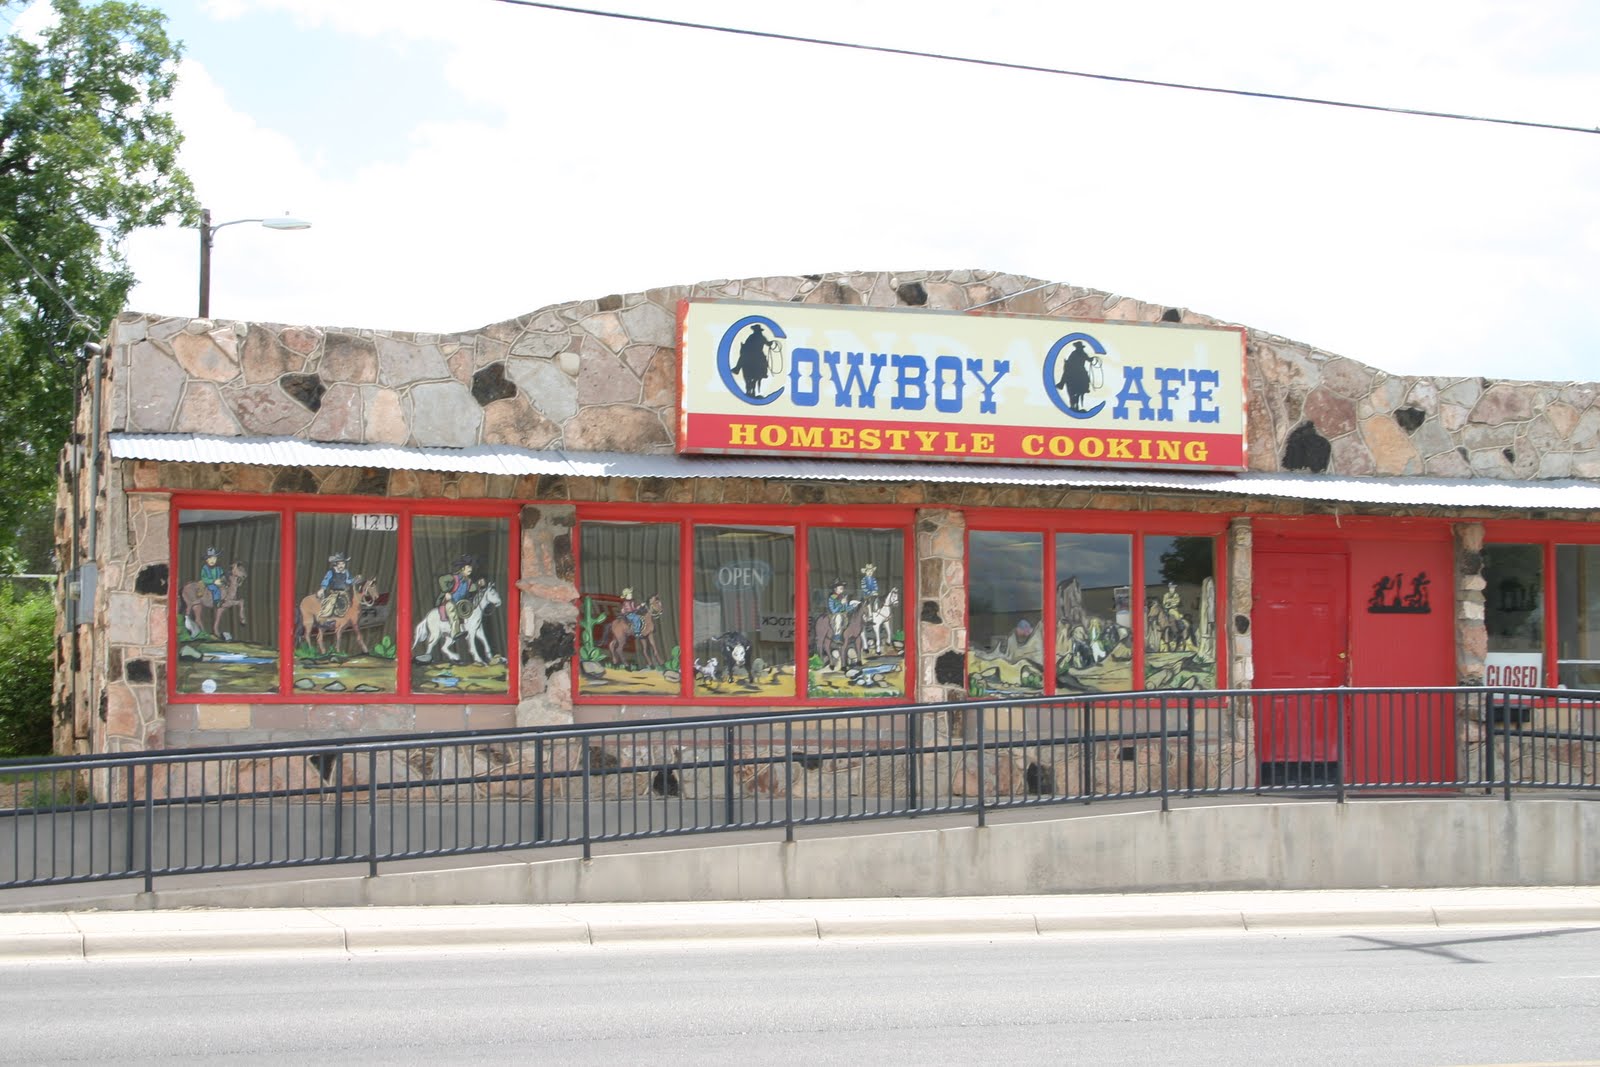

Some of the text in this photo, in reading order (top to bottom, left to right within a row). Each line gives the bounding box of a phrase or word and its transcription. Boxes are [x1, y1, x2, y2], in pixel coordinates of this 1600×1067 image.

[717, 315, 1010, 414] COWBOY
[1042, 332, 1220, 423] CAFE
[728, 423, 1209, 462] HOMESTYLE COOKING
[354, 514, 395, 530] 1120
[718, 566, 764, 586] OPEN
[1487, 664, 1538, 688] CLOSED
